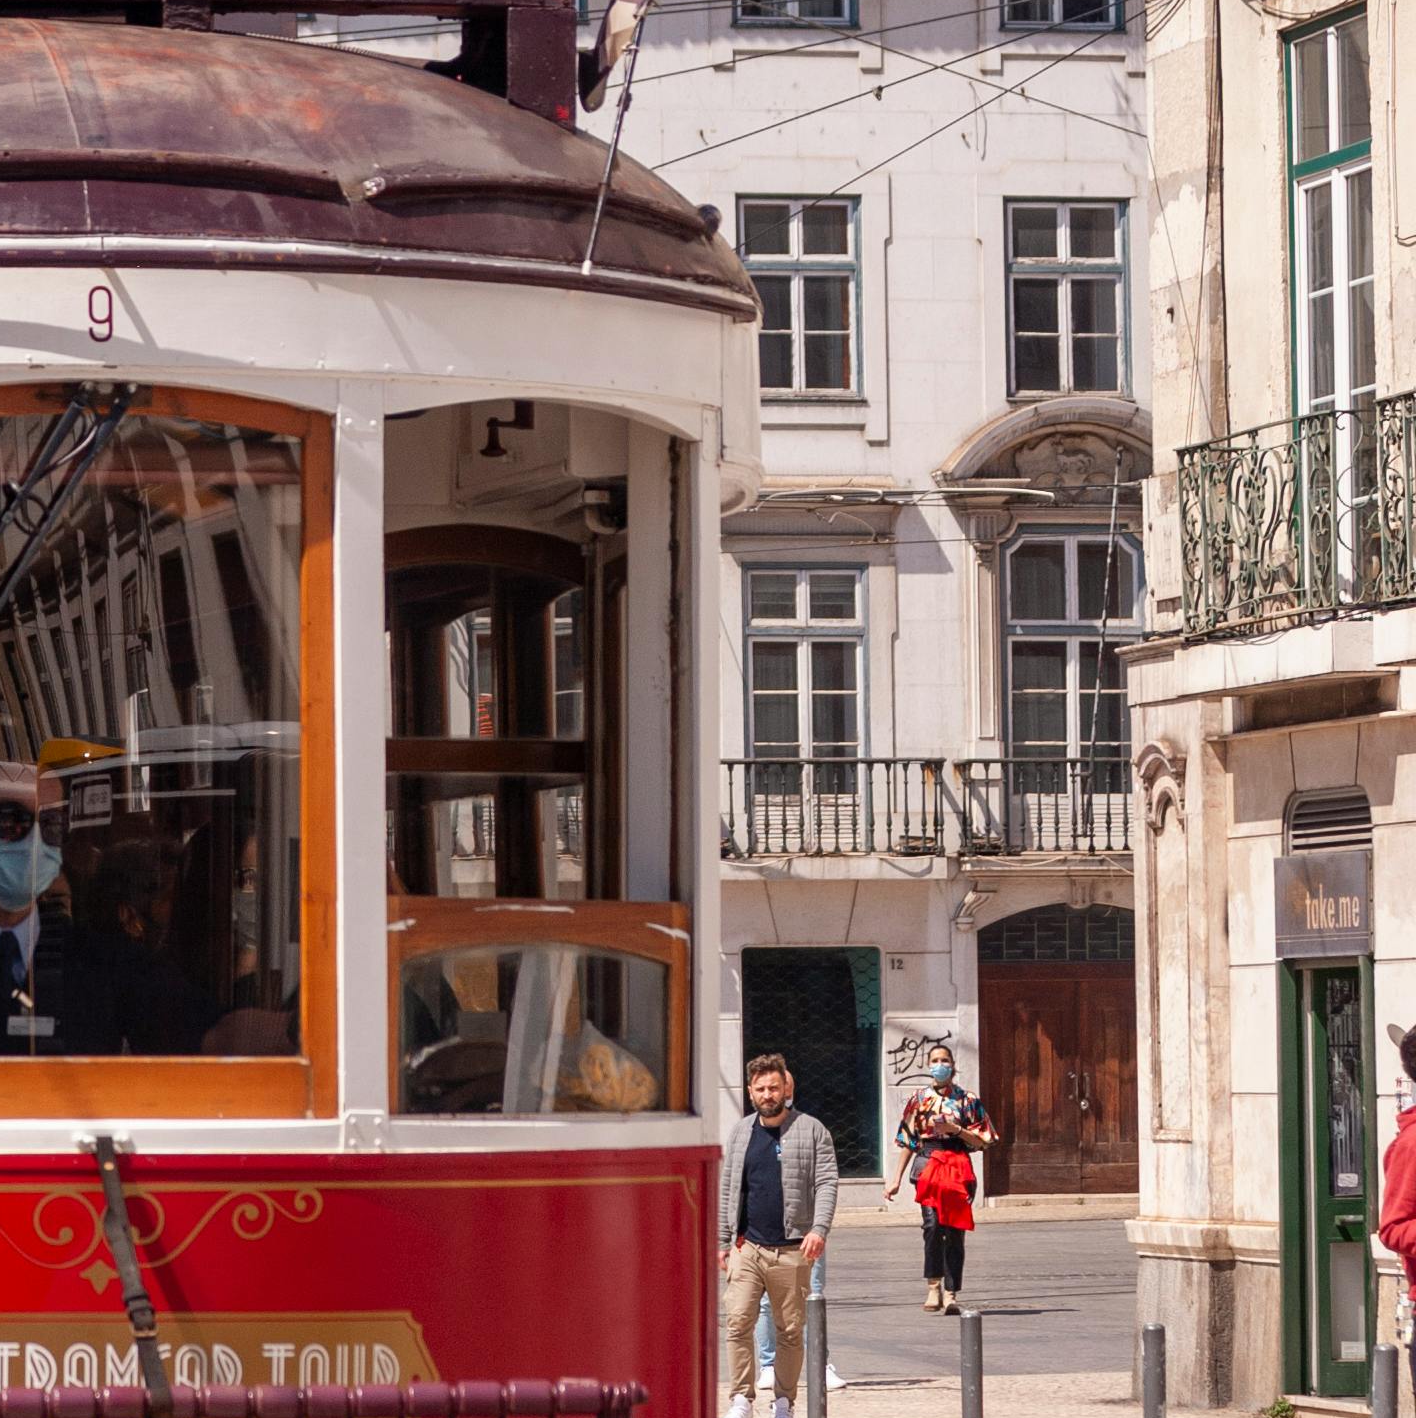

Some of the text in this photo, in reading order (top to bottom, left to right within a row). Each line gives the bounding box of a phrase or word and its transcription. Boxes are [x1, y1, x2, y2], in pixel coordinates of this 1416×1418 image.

[88, 285, 113, 342] 9
[1305, 883, 1360, 930] take.me
[890, 958, 904, 970] 12
